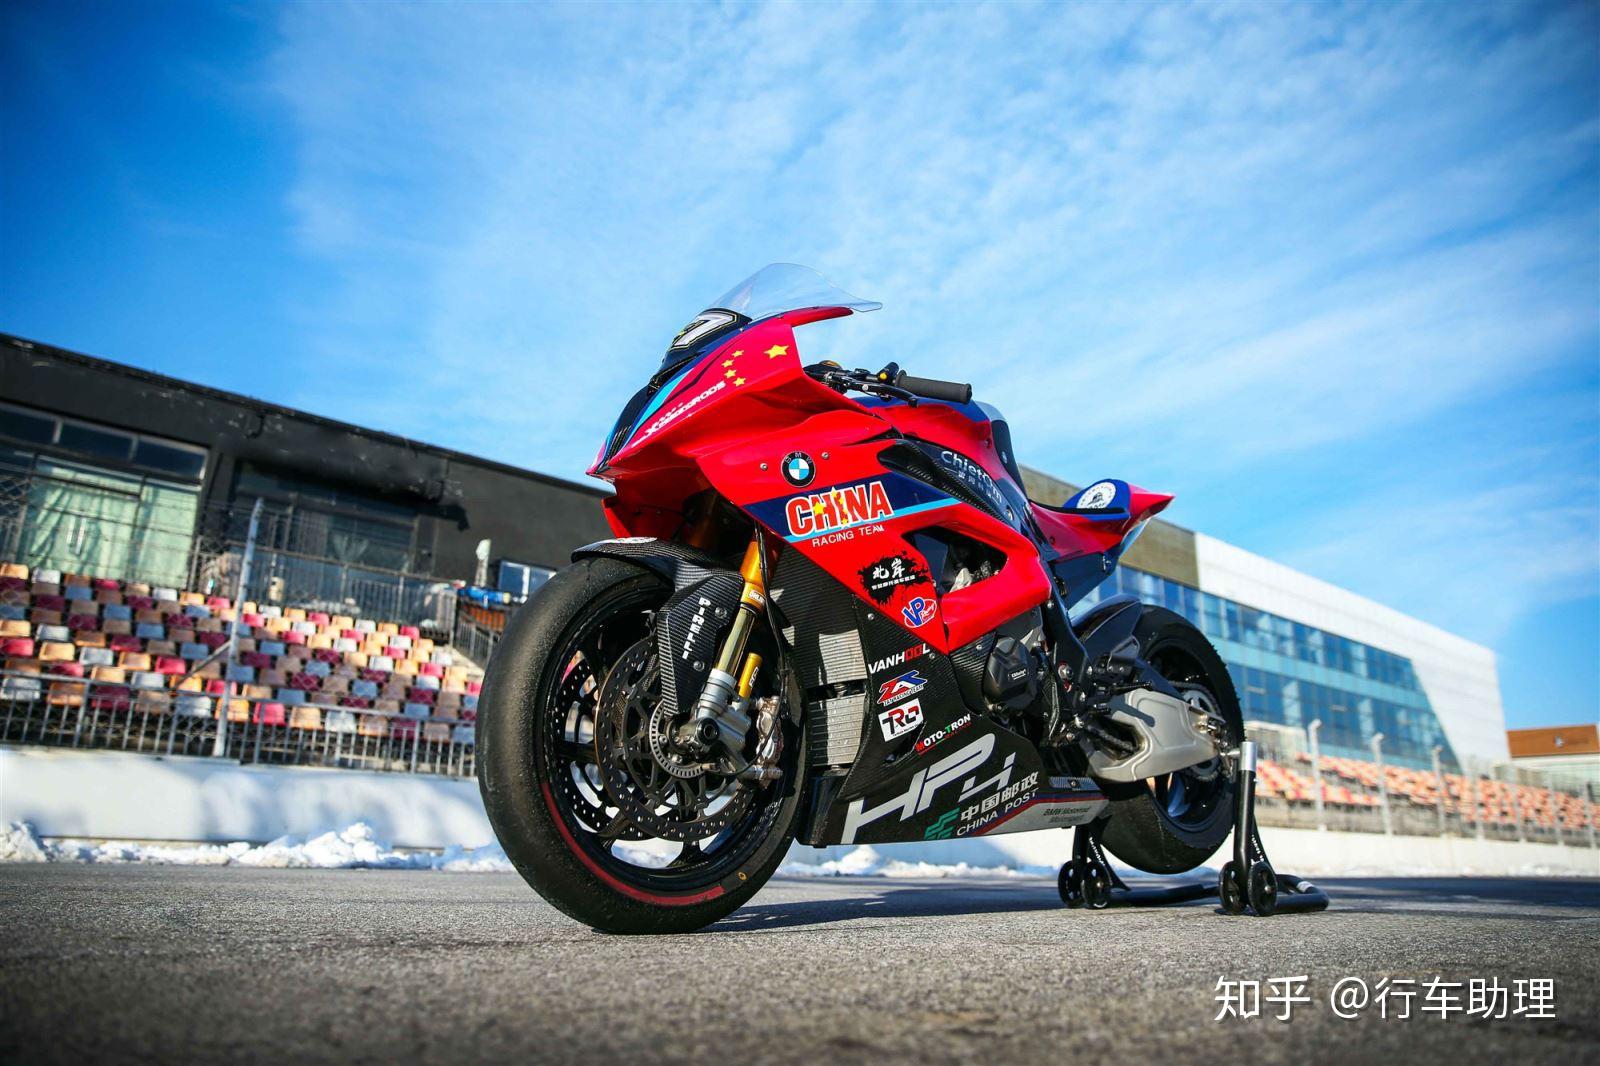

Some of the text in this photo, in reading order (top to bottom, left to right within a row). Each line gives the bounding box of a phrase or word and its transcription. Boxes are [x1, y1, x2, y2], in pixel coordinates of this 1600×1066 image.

[785, 481, 894, 537] CHINA
[812, 524, 885, 547] RACING TEAM
[681, 597, 712, 660] PIRELLI
[901, 596, 925, 627] VP
[867, 643, 931, 675] VANHOOL
[915, 713, 971, 752] MOTO-TRON
[956, 787, 1039, 836] CHINA POST
[960, 771, 1039, 821] 中国邮政
